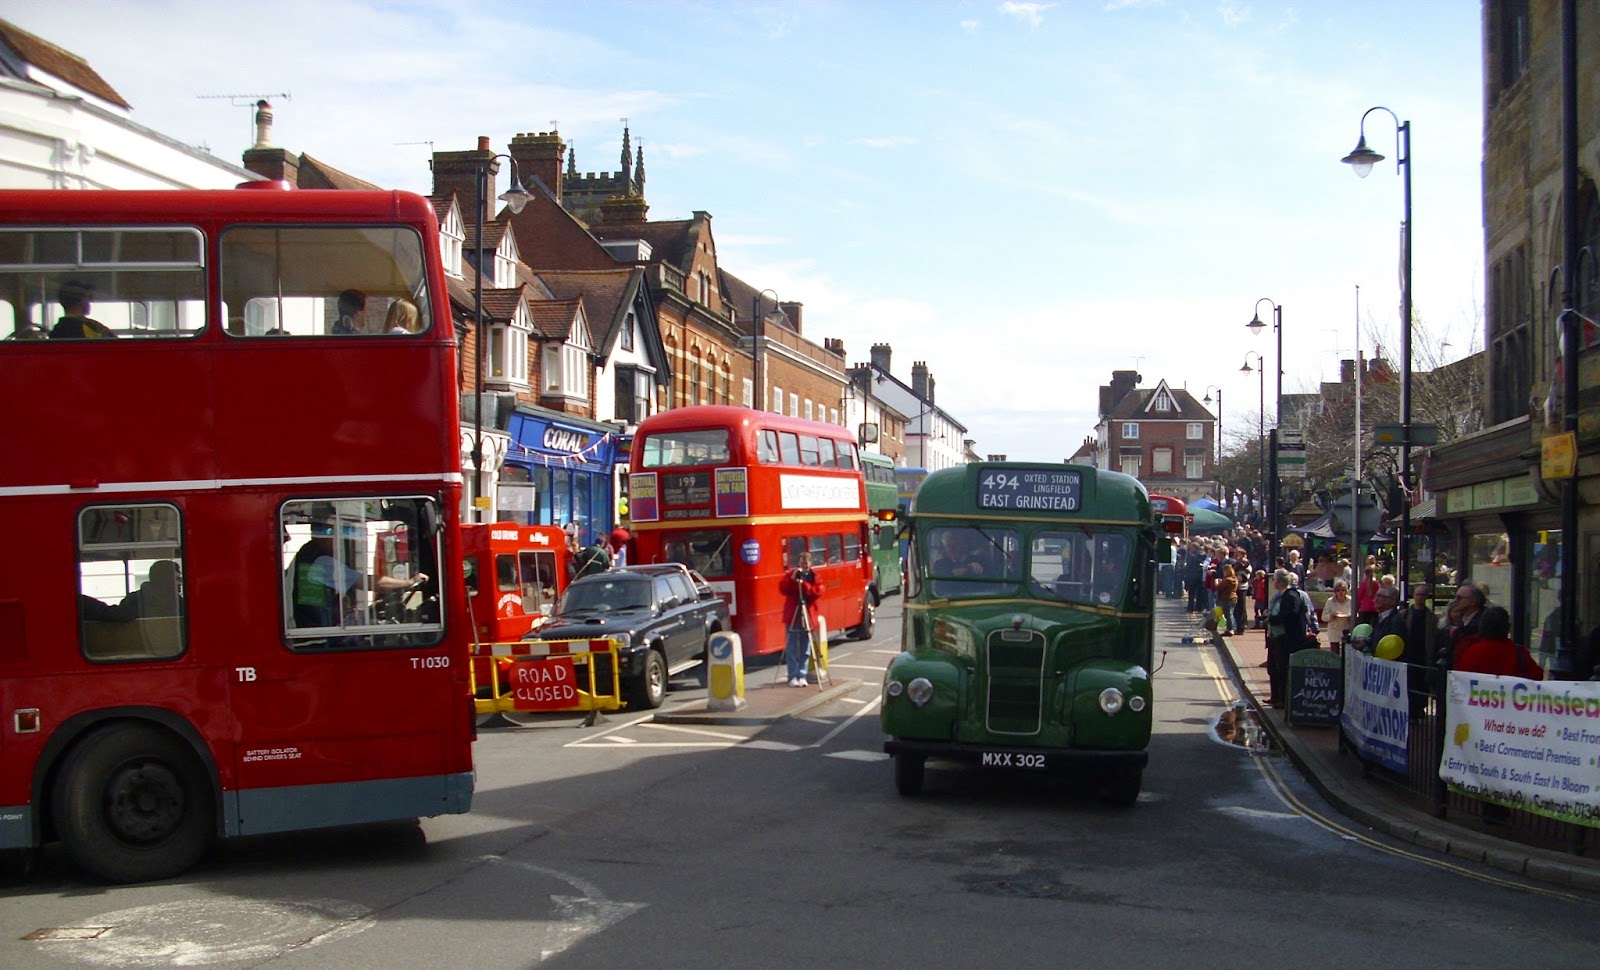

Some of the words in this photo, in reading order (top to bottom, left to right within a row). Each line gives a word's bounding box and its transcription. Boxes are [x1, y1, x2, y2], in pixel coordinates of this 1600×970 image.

[542, 428, 582, 453] CORAL
[679, 476, 697, 487] 199
[983, 474, 1019, 490] 494
[1024, 474, 1047, 483] OXTED
[1051, 475, 1079, 485] STATION
[1033, 484, 1071, 494] LINGFIELD
[983, 493, 1010, 507] EAST
[1016, 495, 1076, 510] GRINSTEAD
[235, 667, 257, 682] TB
[518, 664, 567, 684] ROAD
[1304, 677, 1331, 688] NEW
[516, 684, 575, 702] CLOSED
[1467, 679, 1506, 709] East
[1484, 719, 1505, 733] What
[1506, 722, 1516, 735] do
[1518, 726, 1530, 736] we
[1532, 725, 1547, 739] do?
[1562, 727, 1580, 742] Best
[982, 752, 1012, 766] MXX
[1015, 754, 1045, 768] 302
[1479, 739, 1496, 753] Best
[1497, 742, 1545, 761] Commercial
[1545, 748, 1581, 766] Premises
[1448, 758, 1468, 775] Entry
[1480, 763, 1500, 779] South
[1501, 767, 1508, 780] &
[1509, 768, 1532, 784] South
[1533, 772, 1551, 788] East
[1551, 775, 1560, 789] In
[1561, 776, 1590, 794] Bloom
